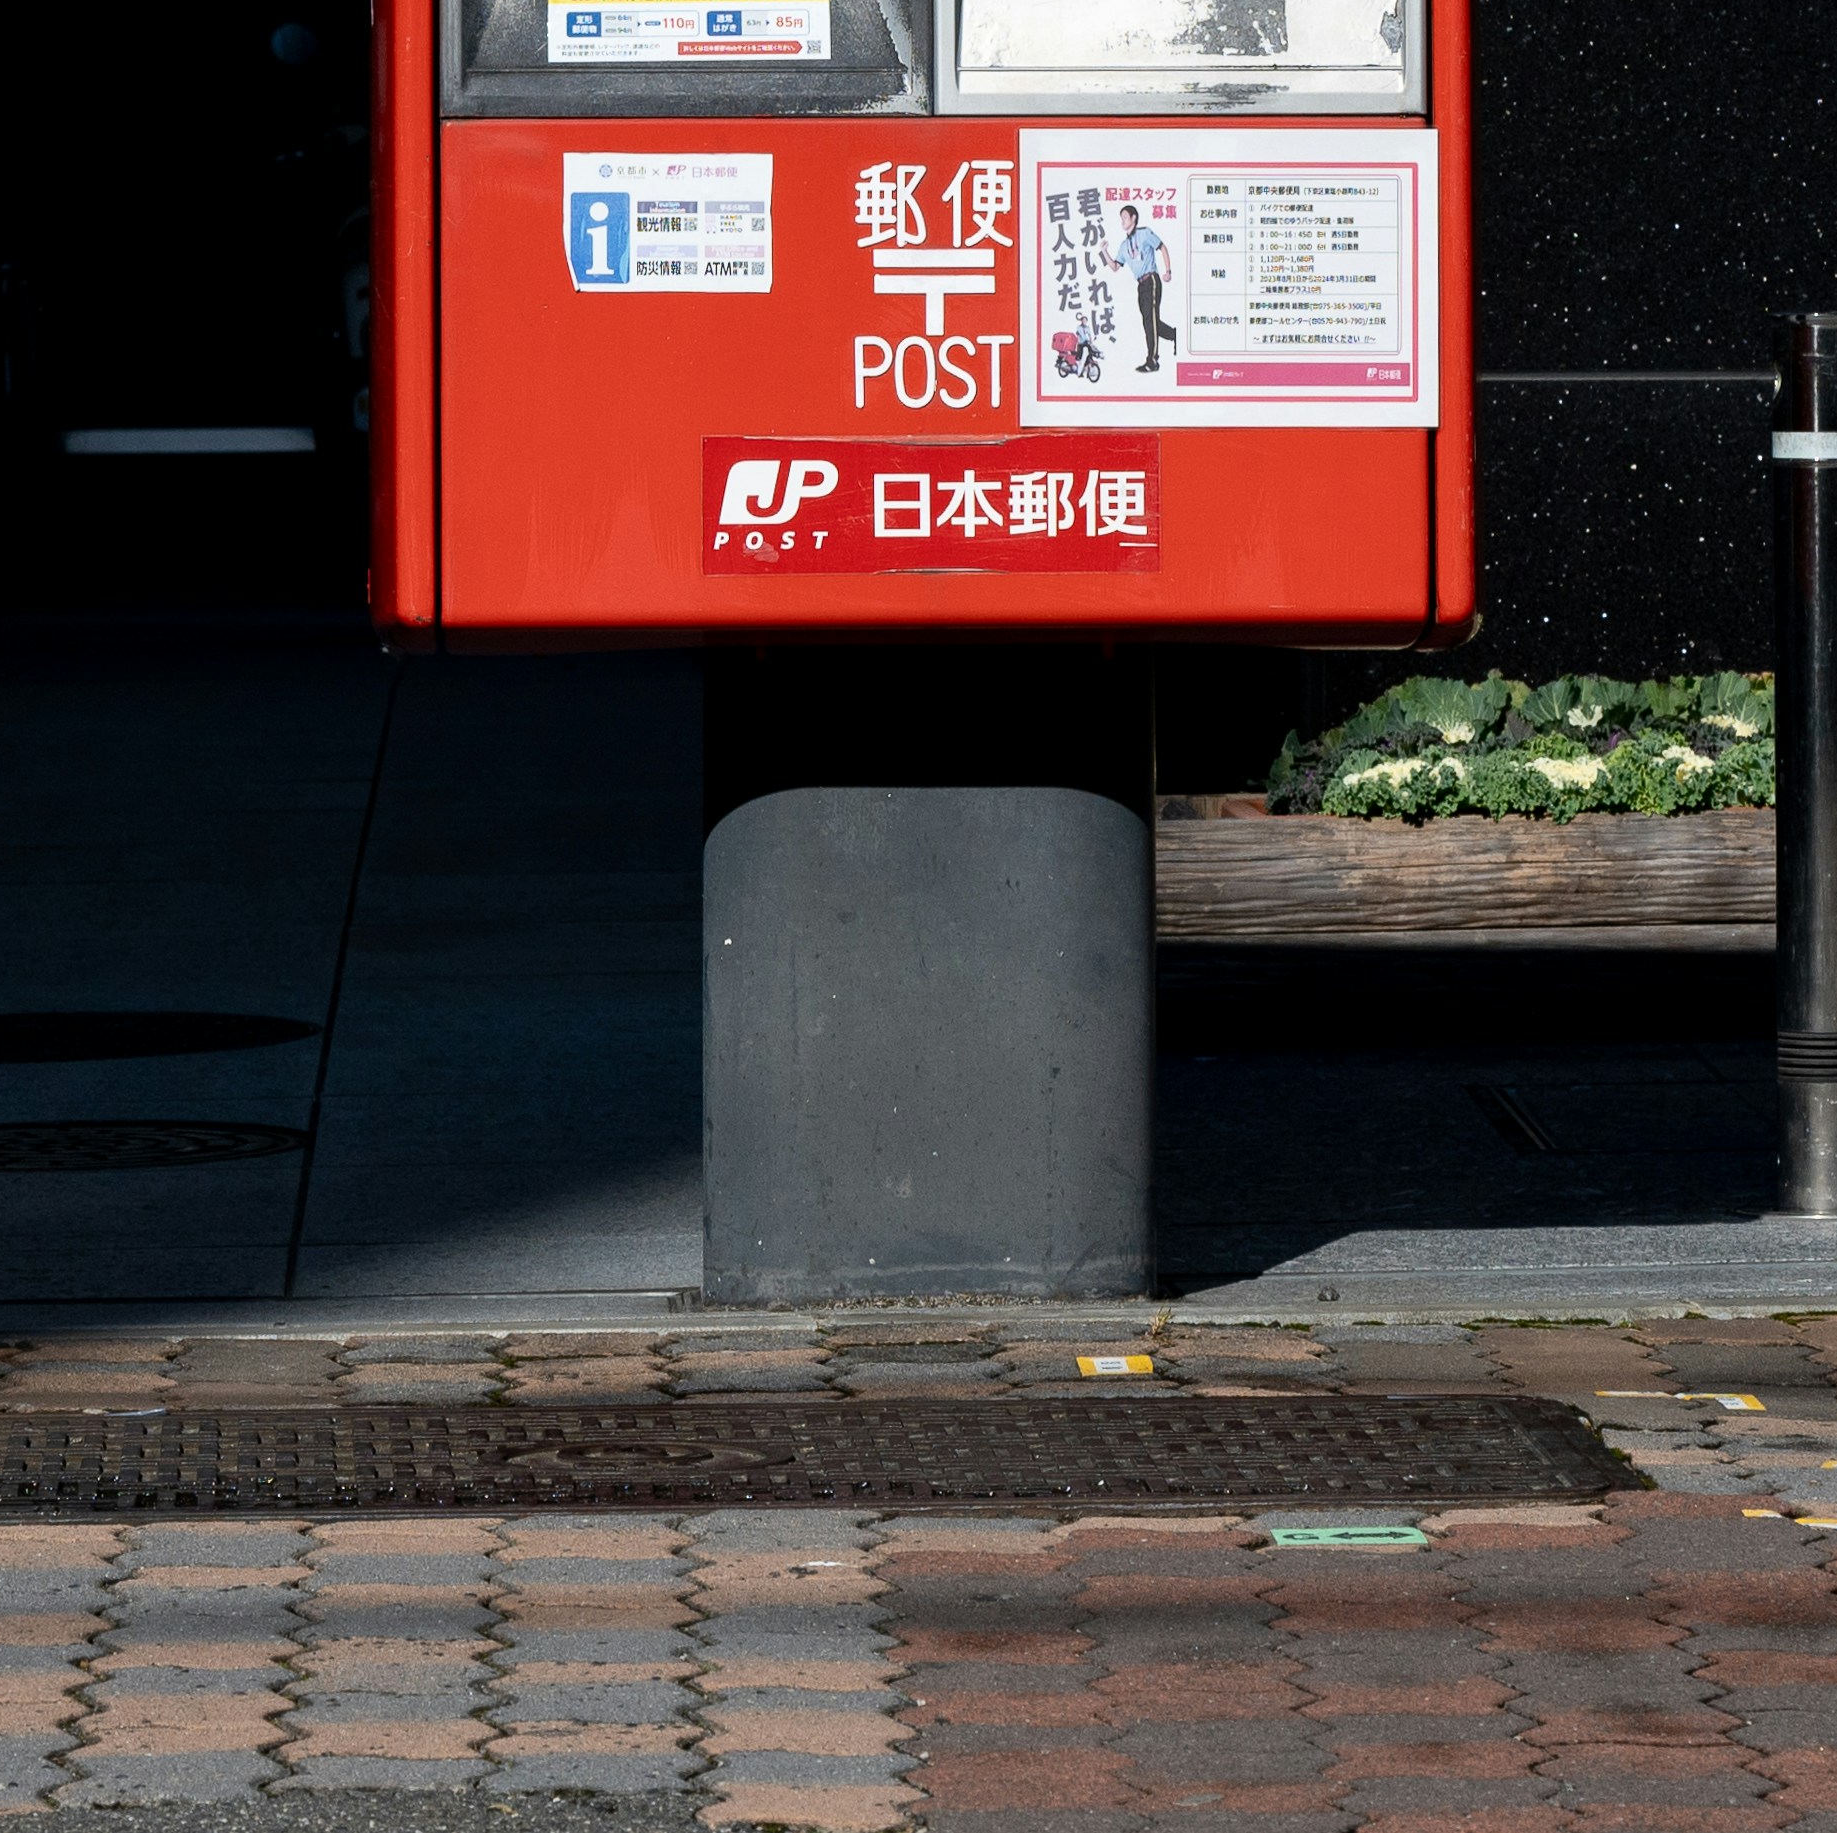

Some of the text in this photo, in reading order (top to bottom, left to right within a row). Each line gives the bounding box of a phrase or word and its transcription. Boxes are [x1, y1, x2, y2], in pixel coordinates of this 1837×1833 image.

[664, 17, 695, 29] 110円
[776, 16, 803, 28] 85円
[617, 167, 647, 176] 京都市
[692, 167, 738, 178] 日本郵便
[1105, 187, 1177, 201] 配達スタッフ
[855, 160, 1014, 248] 郵便
[1152, 205, 1177, 218] 募集
[637, 217, 681, 232] 観光情報
[637, 261, 681, 275] 防災情報
[705, 262, 731, 275] ATM
[1194, 316, 1239, 325] お問い合わせ先
[854, 335, 1014, 408] POST
[874, 469, 1150, 538] 日本郵便
[713, 530, 829, 550] POST
